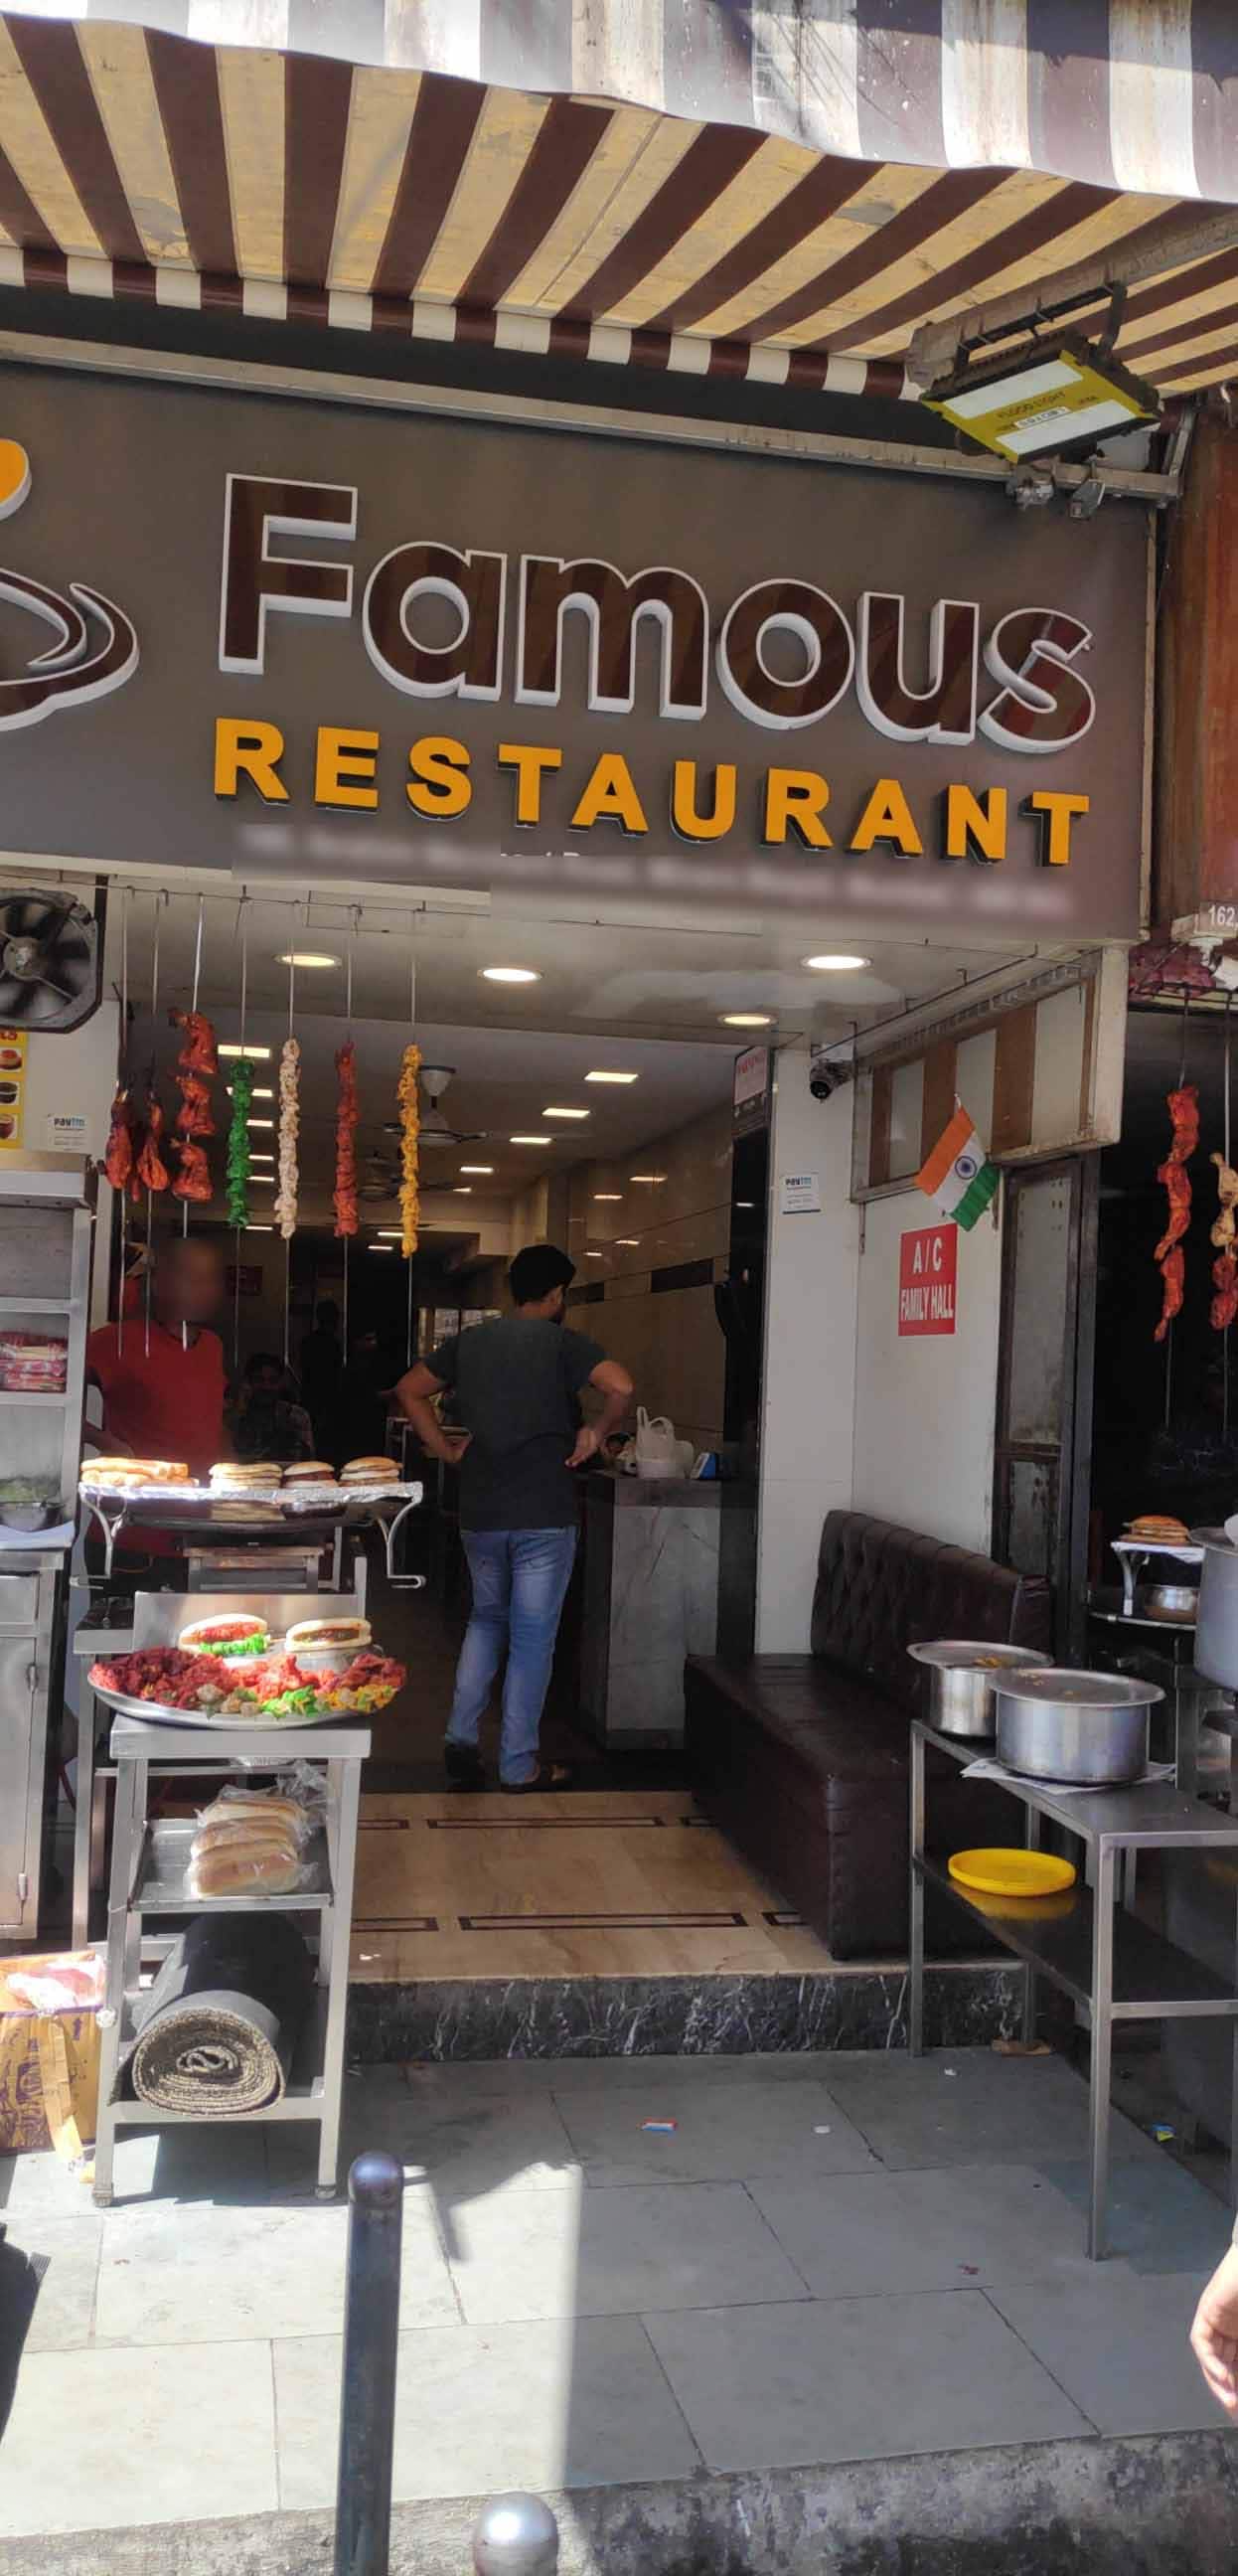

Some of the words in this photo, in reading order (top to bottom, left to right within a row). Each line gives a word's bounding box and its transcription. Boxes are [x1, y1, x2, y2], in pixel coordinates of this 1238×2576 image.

[219, 473, 1095, 752] Famous
[214, 718, 1090, 866] RESTAURANT
[900, 1286, 930, 1320] FAMILY
[930, 1283, 954, 1320] HALL
